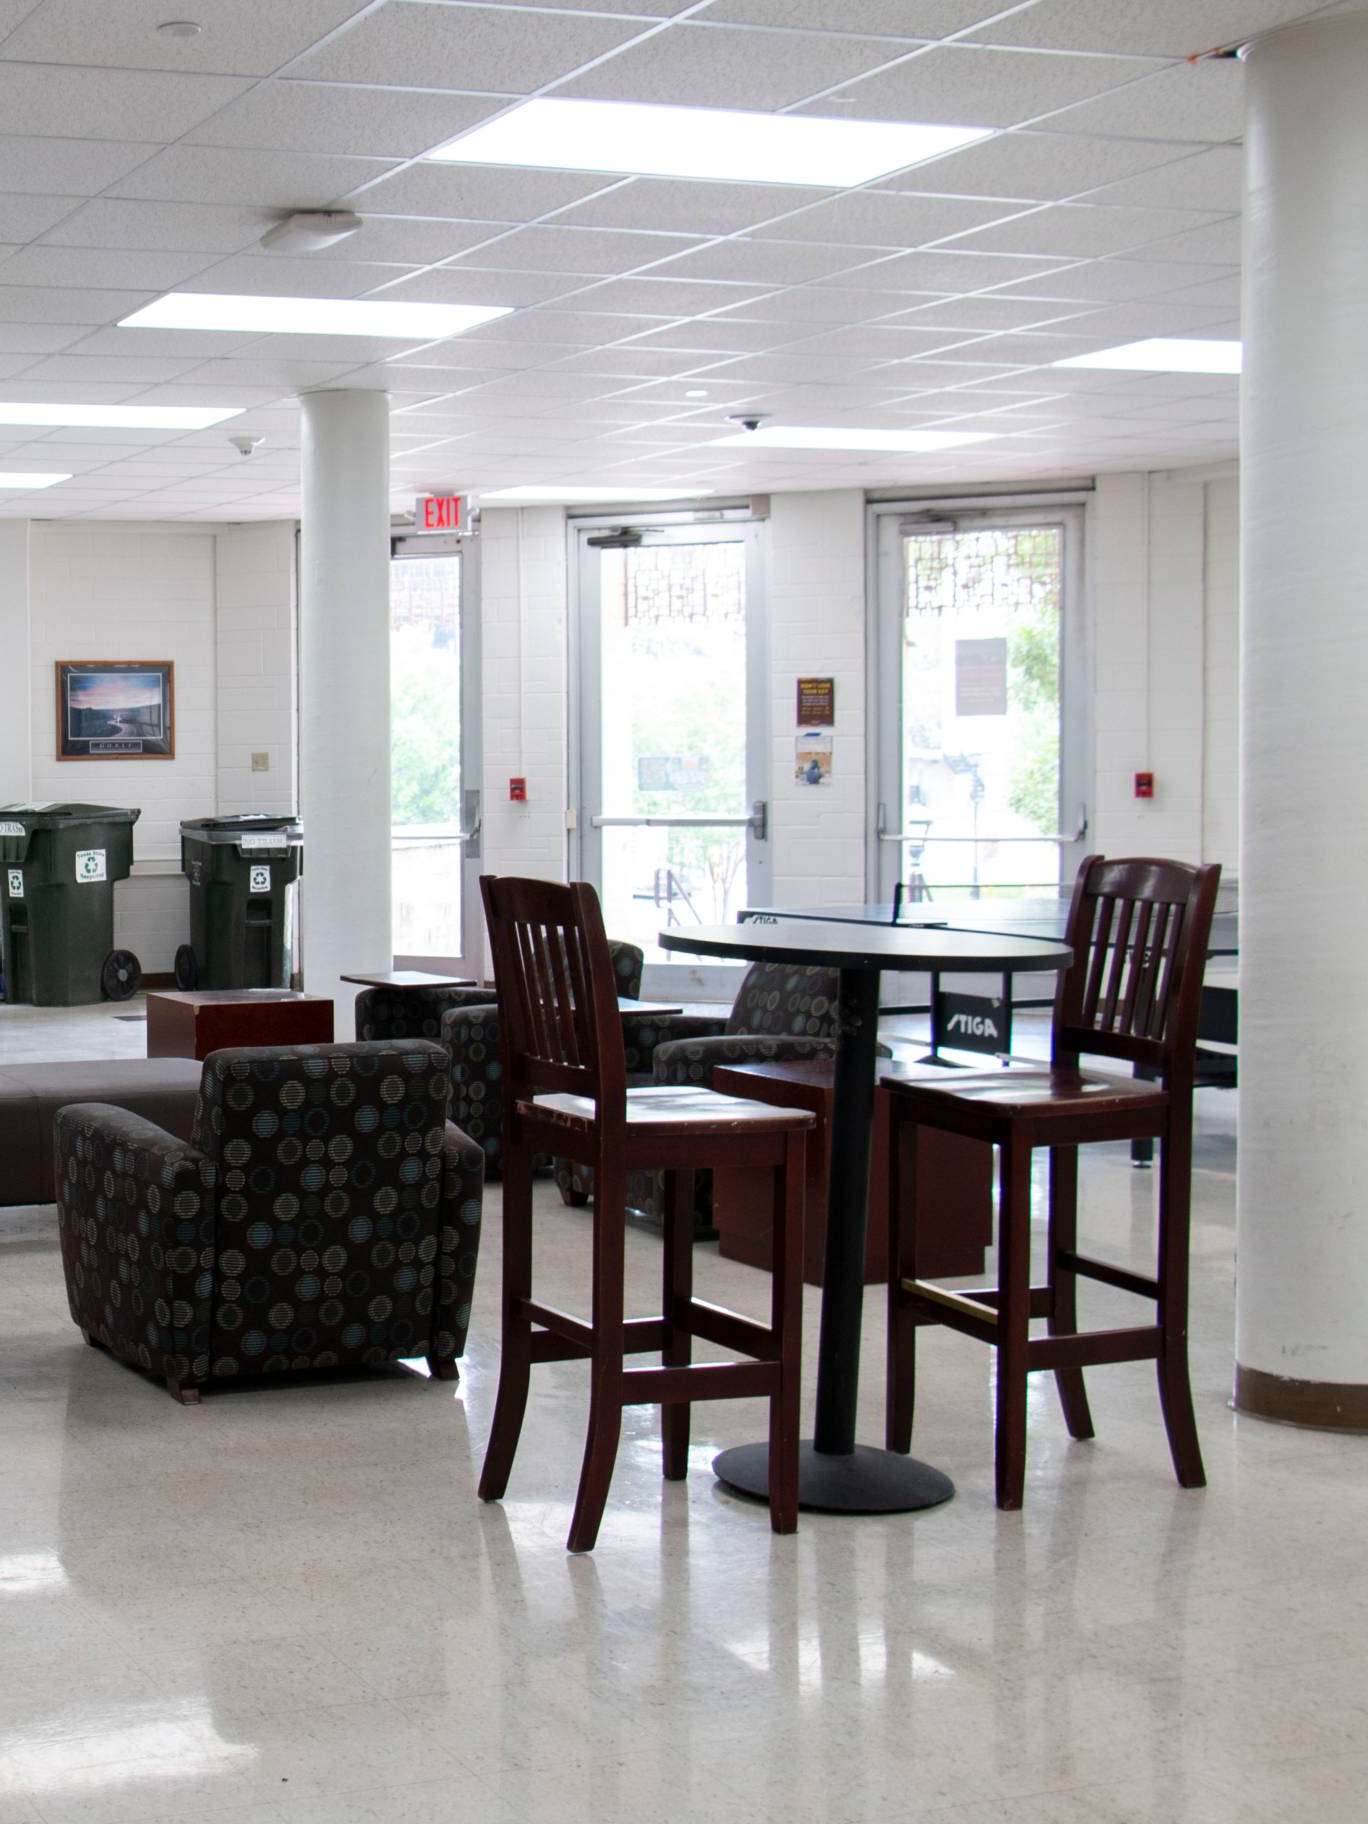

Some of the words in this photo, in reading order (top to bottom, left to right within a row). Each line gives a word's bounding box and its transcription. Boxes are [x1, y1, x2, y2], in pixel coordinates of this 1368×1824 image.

[424, 496, 461, 529] EXIT
[752, 914, 778, 925] STIGA
[946, 1013, 999, 1038] STIGA
